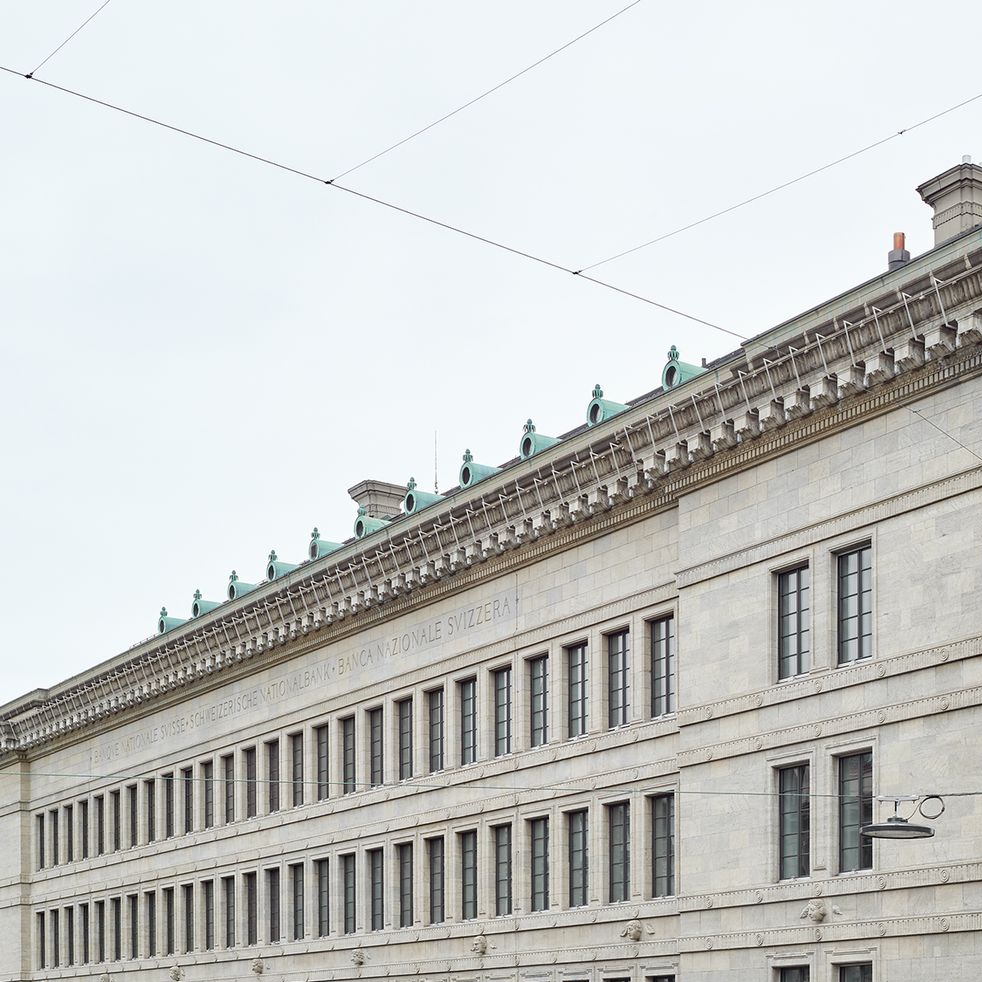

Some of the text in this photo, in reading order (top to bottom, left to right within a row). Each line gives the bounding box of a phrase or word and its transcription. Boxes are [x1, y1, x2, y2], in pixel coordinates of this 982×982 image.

[190, 691, 258, 729] SCHWEIZERISCHE
[260, 663, 330, 702] NATIONALBANK
[338, 649, 373, 675] BANCA
[377, 621, 442, 660] NAZIONALE
[448, 597, 511, 636] SVIZZERA
